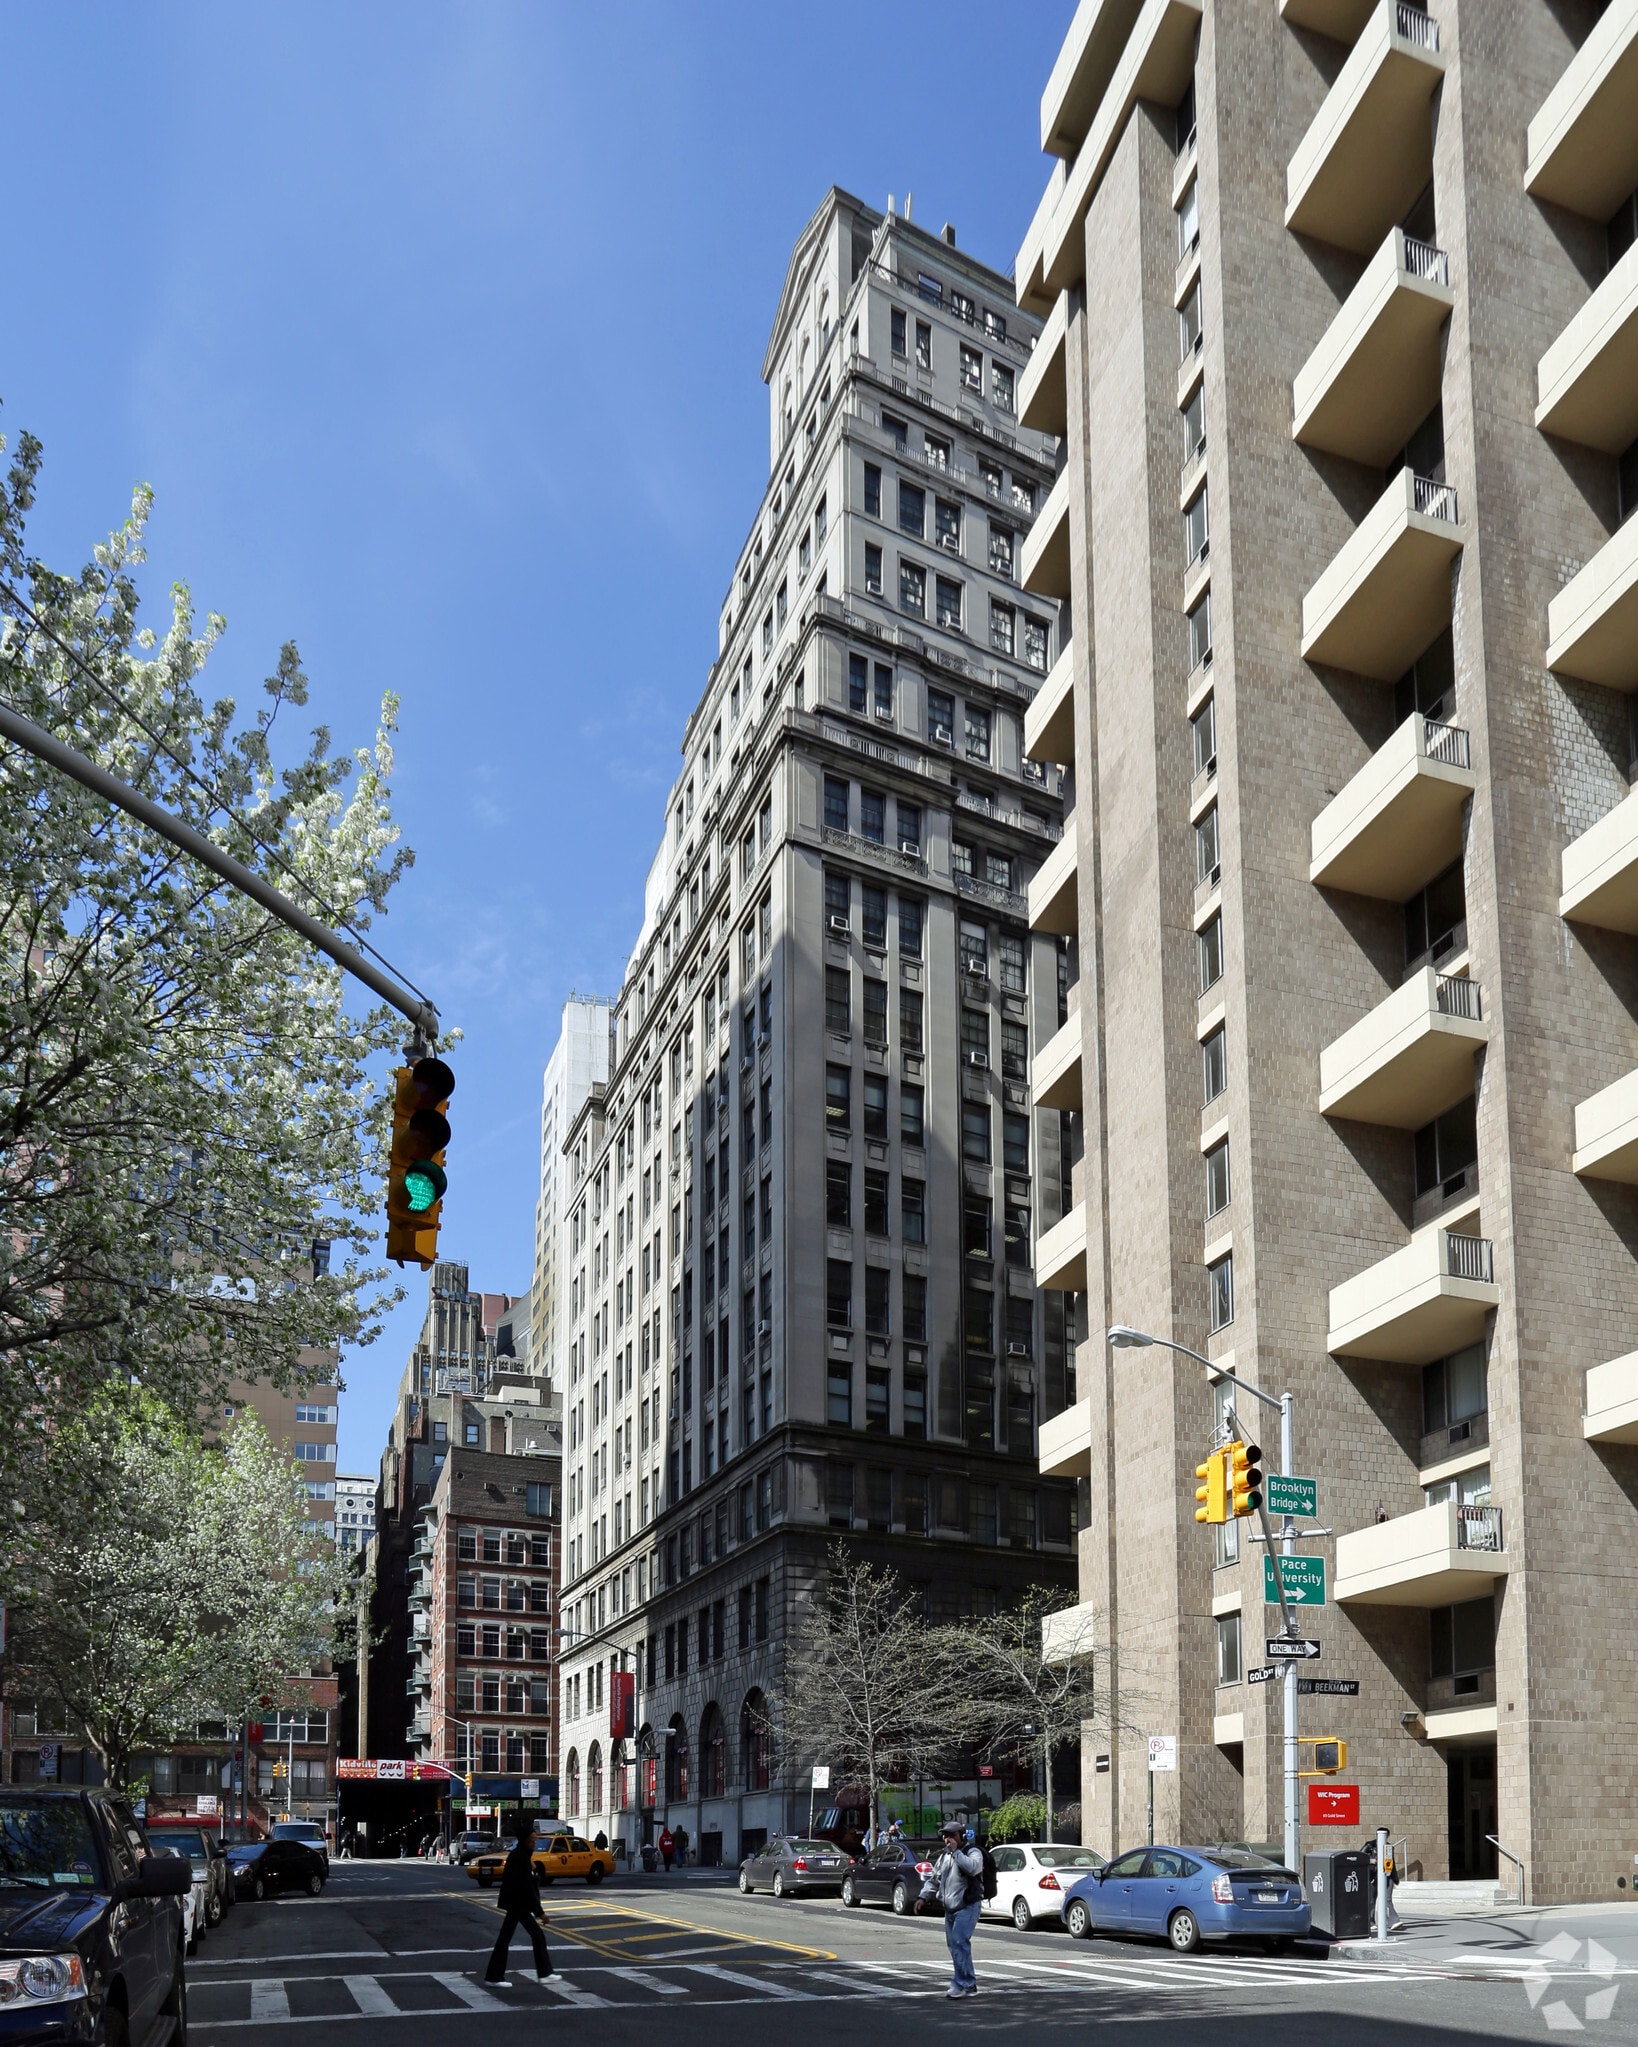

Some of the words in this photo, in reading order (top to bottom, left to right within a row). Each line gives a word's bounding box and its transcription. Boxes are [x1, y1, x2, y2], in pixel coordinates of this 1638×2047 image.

[1270, 1481, 1314, 1497] Brooklyn
[1270, 1497, 1298, 1511] Bridge
[1281, 1559, 1307, 1570] Pace
[1267, 1571, 1322, 1587] Uiversity
[1271, 1645, 1288, 1653] ONE
[1290, 1644, 1306, 1653] WAY
[1249, 1670, 1269, 1682] GOLD
[1315, 1682, 1350, 1693] BEEKMAN
[379, 1761, 403, 1771] park
[1328, 1791, 1351, 1799] Program
